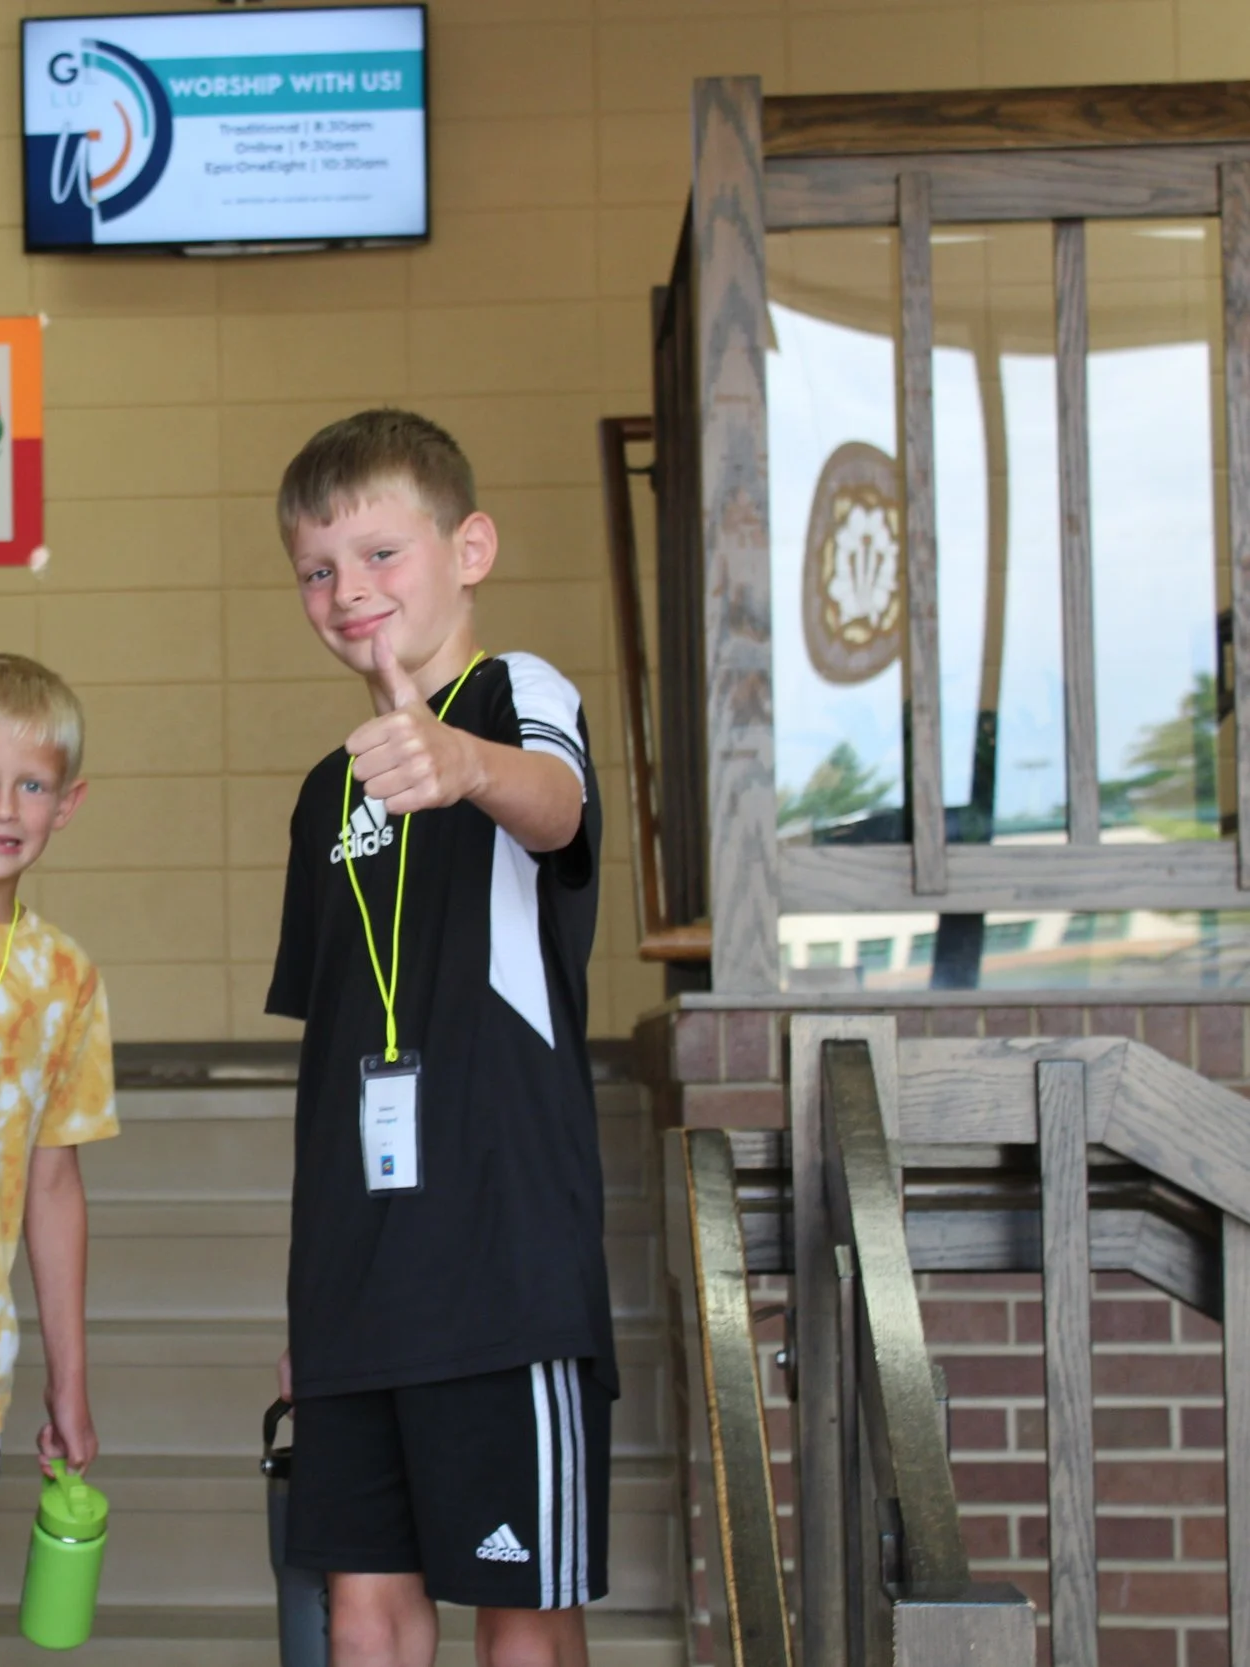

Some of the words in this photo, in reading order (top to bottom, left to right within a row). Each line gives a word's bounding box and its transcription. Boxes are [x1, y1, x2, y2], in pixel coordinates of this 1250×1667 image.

[169, 73, 283, 97] WORSHIP
[290, 70, 355, 93] WITH
[361, 69, 402, 92] US!
[219, 121, 300, 134] Traditional
[234, 141, 283, 154] Online
[476, 1546, 530, 1562] adidas
